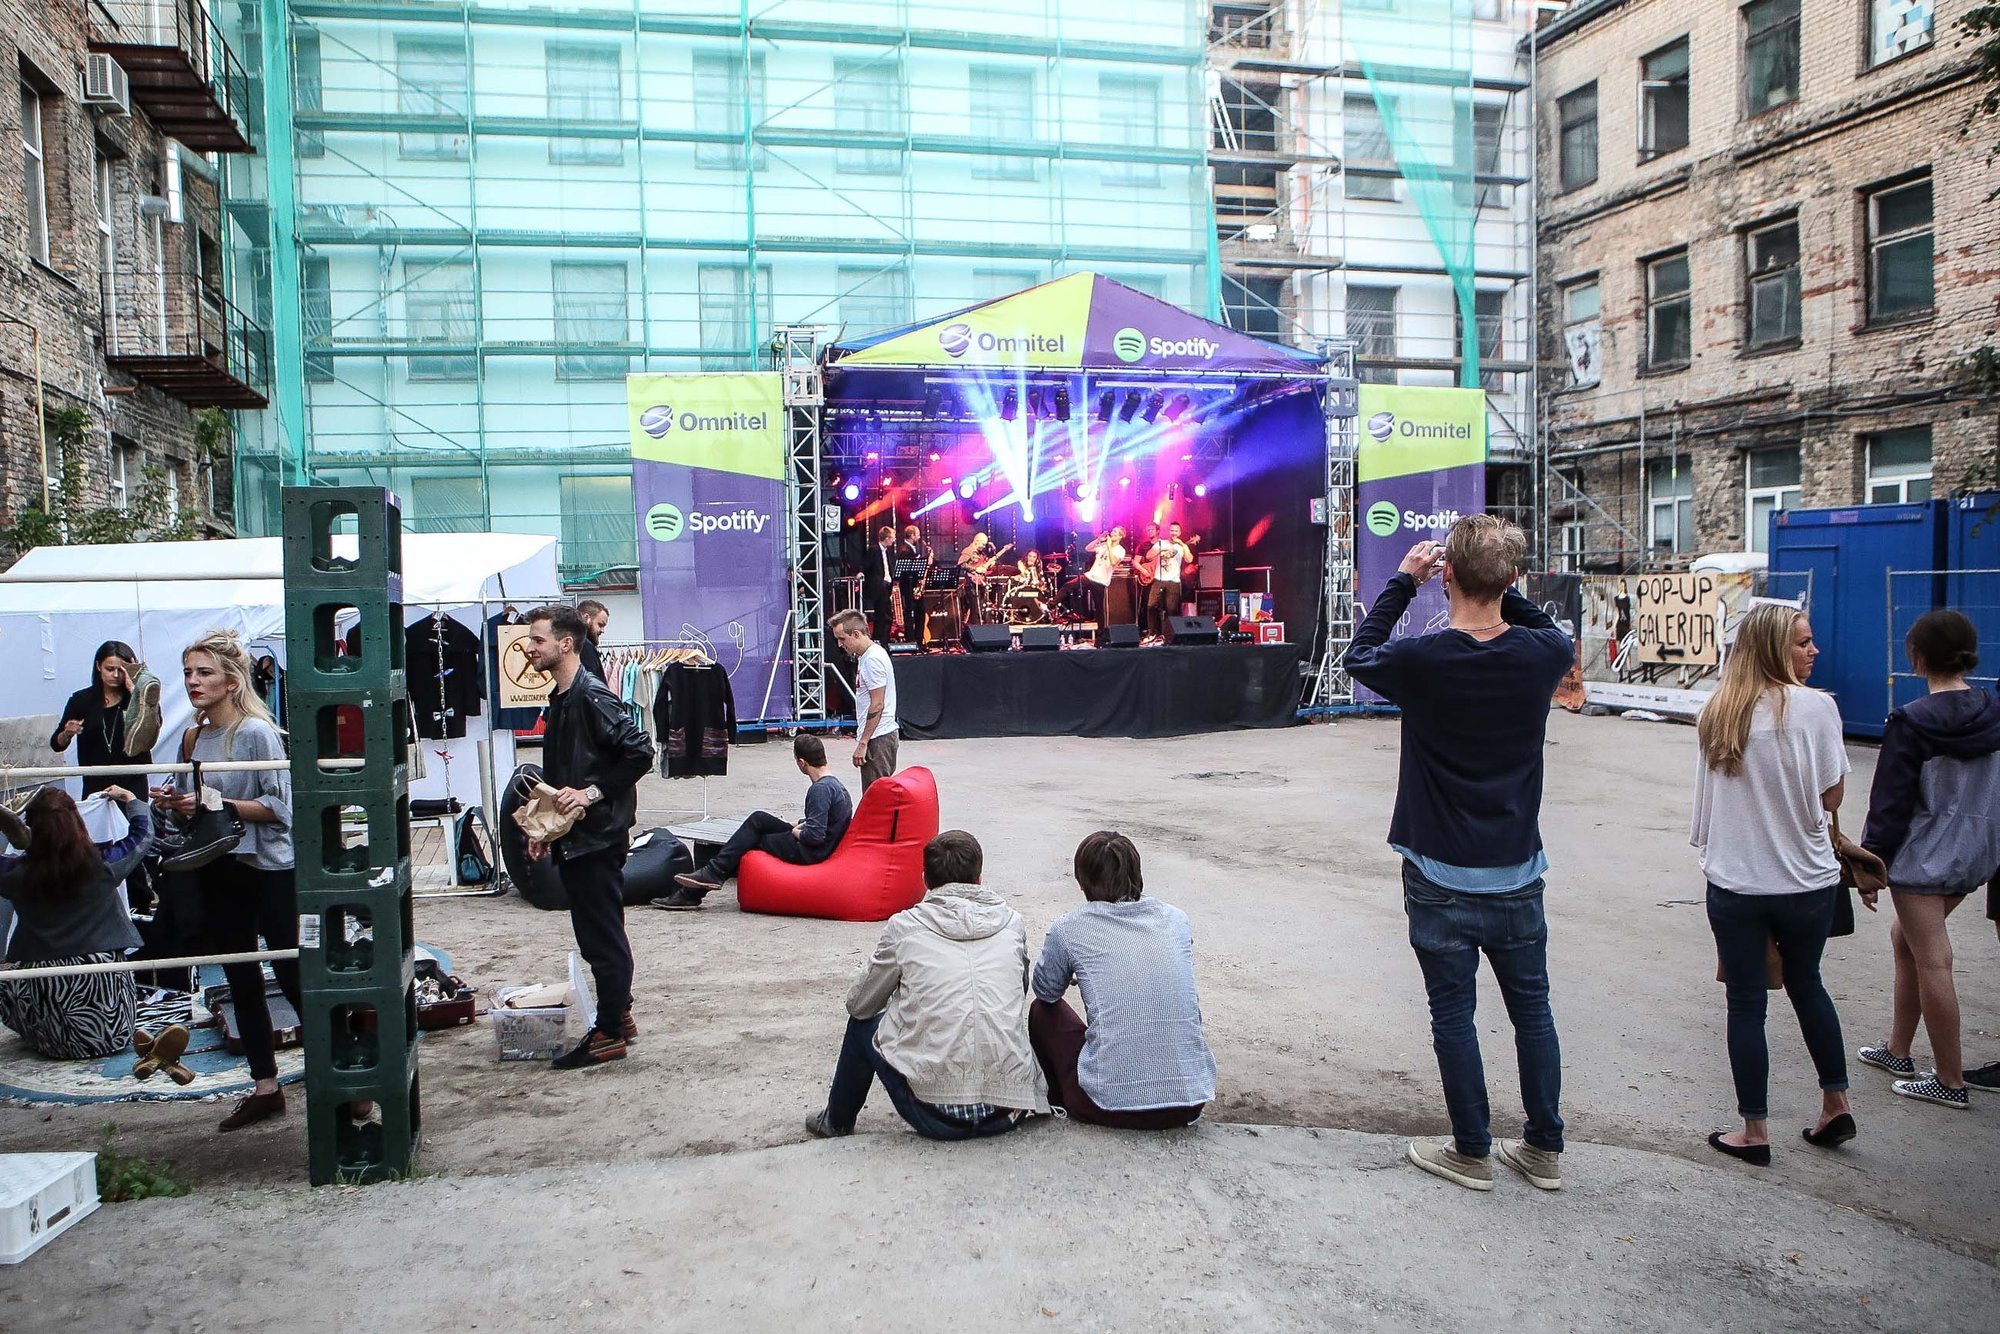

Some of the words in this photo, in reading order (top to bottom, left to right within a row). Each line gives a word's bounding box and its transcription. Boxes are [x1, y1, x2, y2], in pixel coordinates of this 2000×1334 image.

[978, 333, 1064, 353] Omnitel
[1150, 337, 1217, 359] Spotify
[679, 412, 767, 431] Omnitel
[1400, 420, 1471, 439] Omnitel
[689, 509, 768, 535] Spotify
[1403, 510, 1460, 532] Spotif
[1637, 576, 1713, 608] POP-UP
[1638, 611, 1715, 655] GALERIJA
